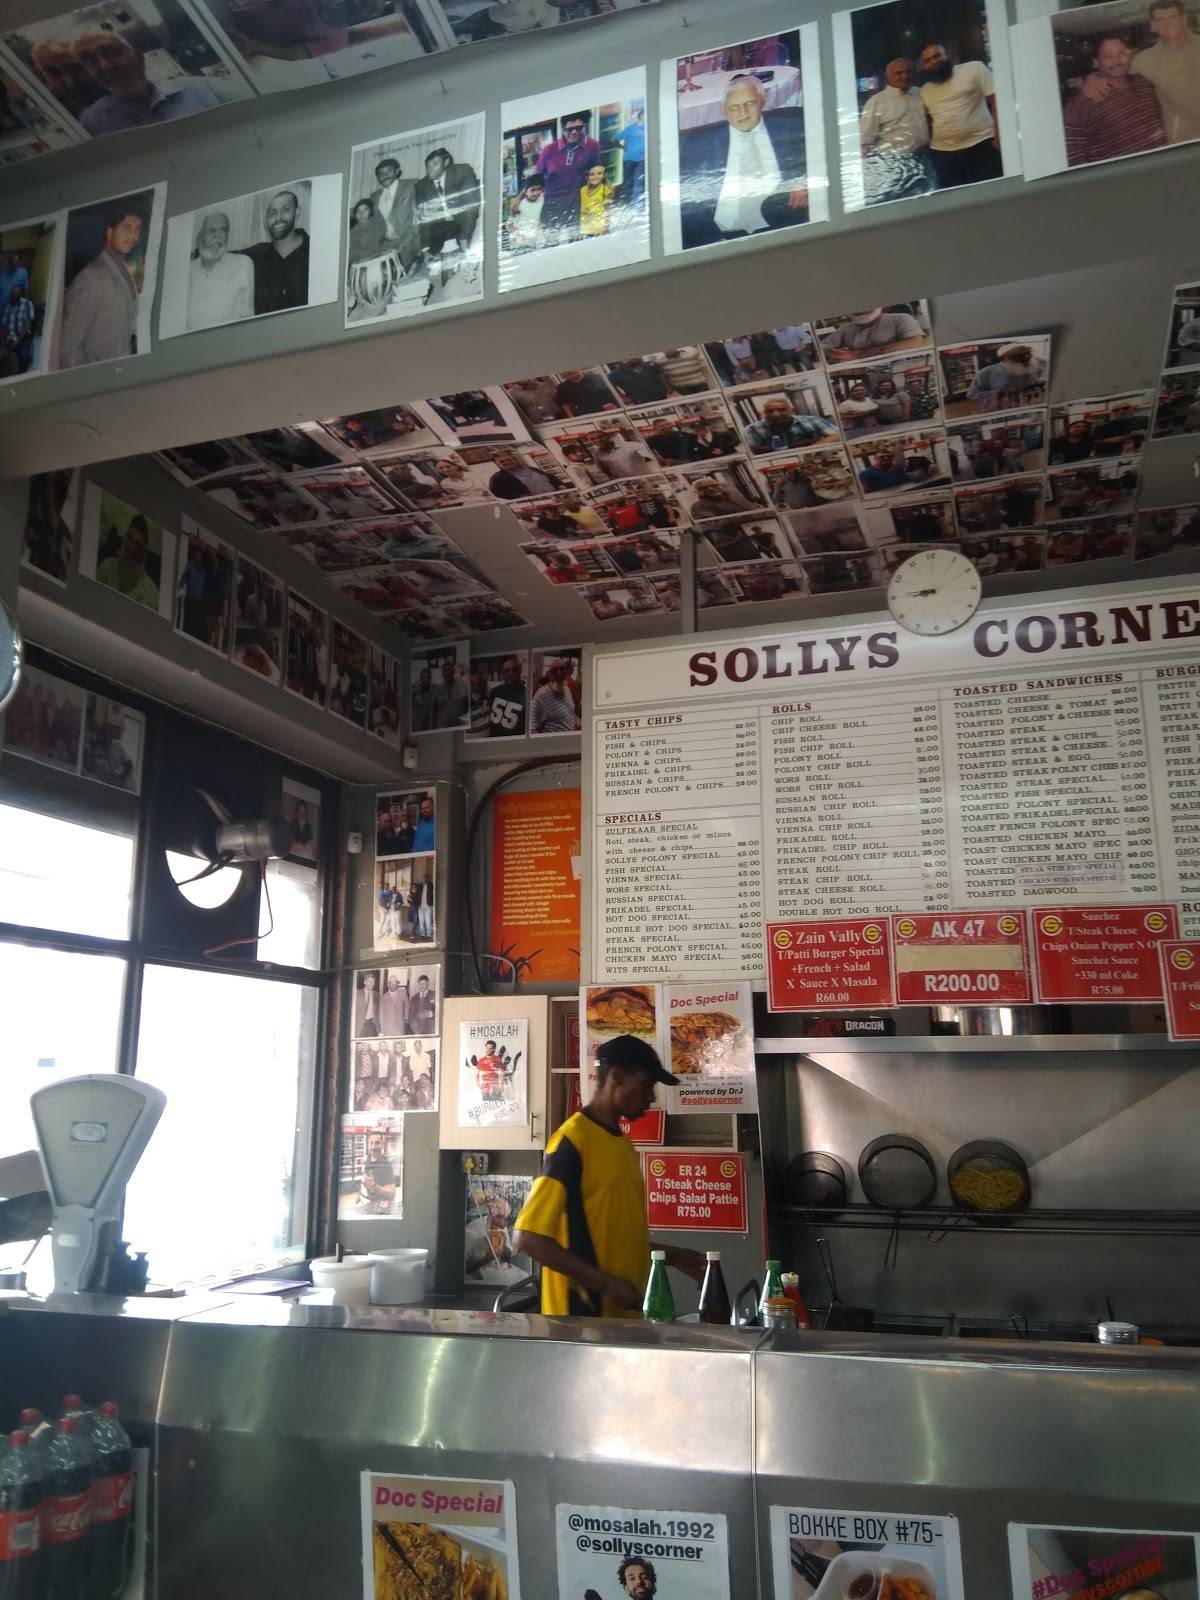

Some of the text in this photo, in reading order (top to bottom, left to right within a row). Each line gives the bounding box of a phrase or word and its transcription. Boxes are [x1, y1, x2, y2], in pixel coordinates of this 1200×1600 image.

[689, 632, 899, 687] SOLLYS
[955, 673, 1122, 696] TOASTED SANDWICHES
[491, 697, 523, 728] 55
[772, 703, 811, 713] ROLLS
[606, 714, 682, 729] TASTY CHIPS
[605, 812, 661, 823] SPECIALS
[931, 920, 985, 937] AK 47
[1105, 926, 1138, 935] Cheese
[796, 930, 863, 944] Zain Vally
[1042, 942, 1069, 952] Chips
[1070, 942, 1098, 950] Onion
[1102, 941, 1134, 951] Pepper
[777, 946, 884, 960] T/Patti Burger Special
[1111, 956, 1138, 964] Sauce
[792, 964, 831, 974] +French
[843, 962, 870, 972] Salad
[1114, 971, 1138, 979] Coke
[787, 977, 877, 989] X Sauce X Masala
[924, 974, 999, 991] R200.00
[670, 991, 739, 1008] Doc Special
[816, 993, 849, 1002] R60.00
[470, 1025, 519, 1037] #MOSALAH
[680, 1088, 715, 1097] powered
[717, 1087, 727, 1095] by
[679, 1166, 707, 1176] ER 24
[656, 1179, 731, 1190] T/Steak Cheese
[650, 1192, 738, 1205] Chips Salad Pattie
[677, 1206, 710, 1217] R75.00
[376, 1487, 504, 1514] Doc Special
[568, 1514, 715, 1539] @mosalah.1992
[789, 1514, 943, 1543] BOKKE BOX #75-
[577, 1535, 703, 1559] @sollyscorner
